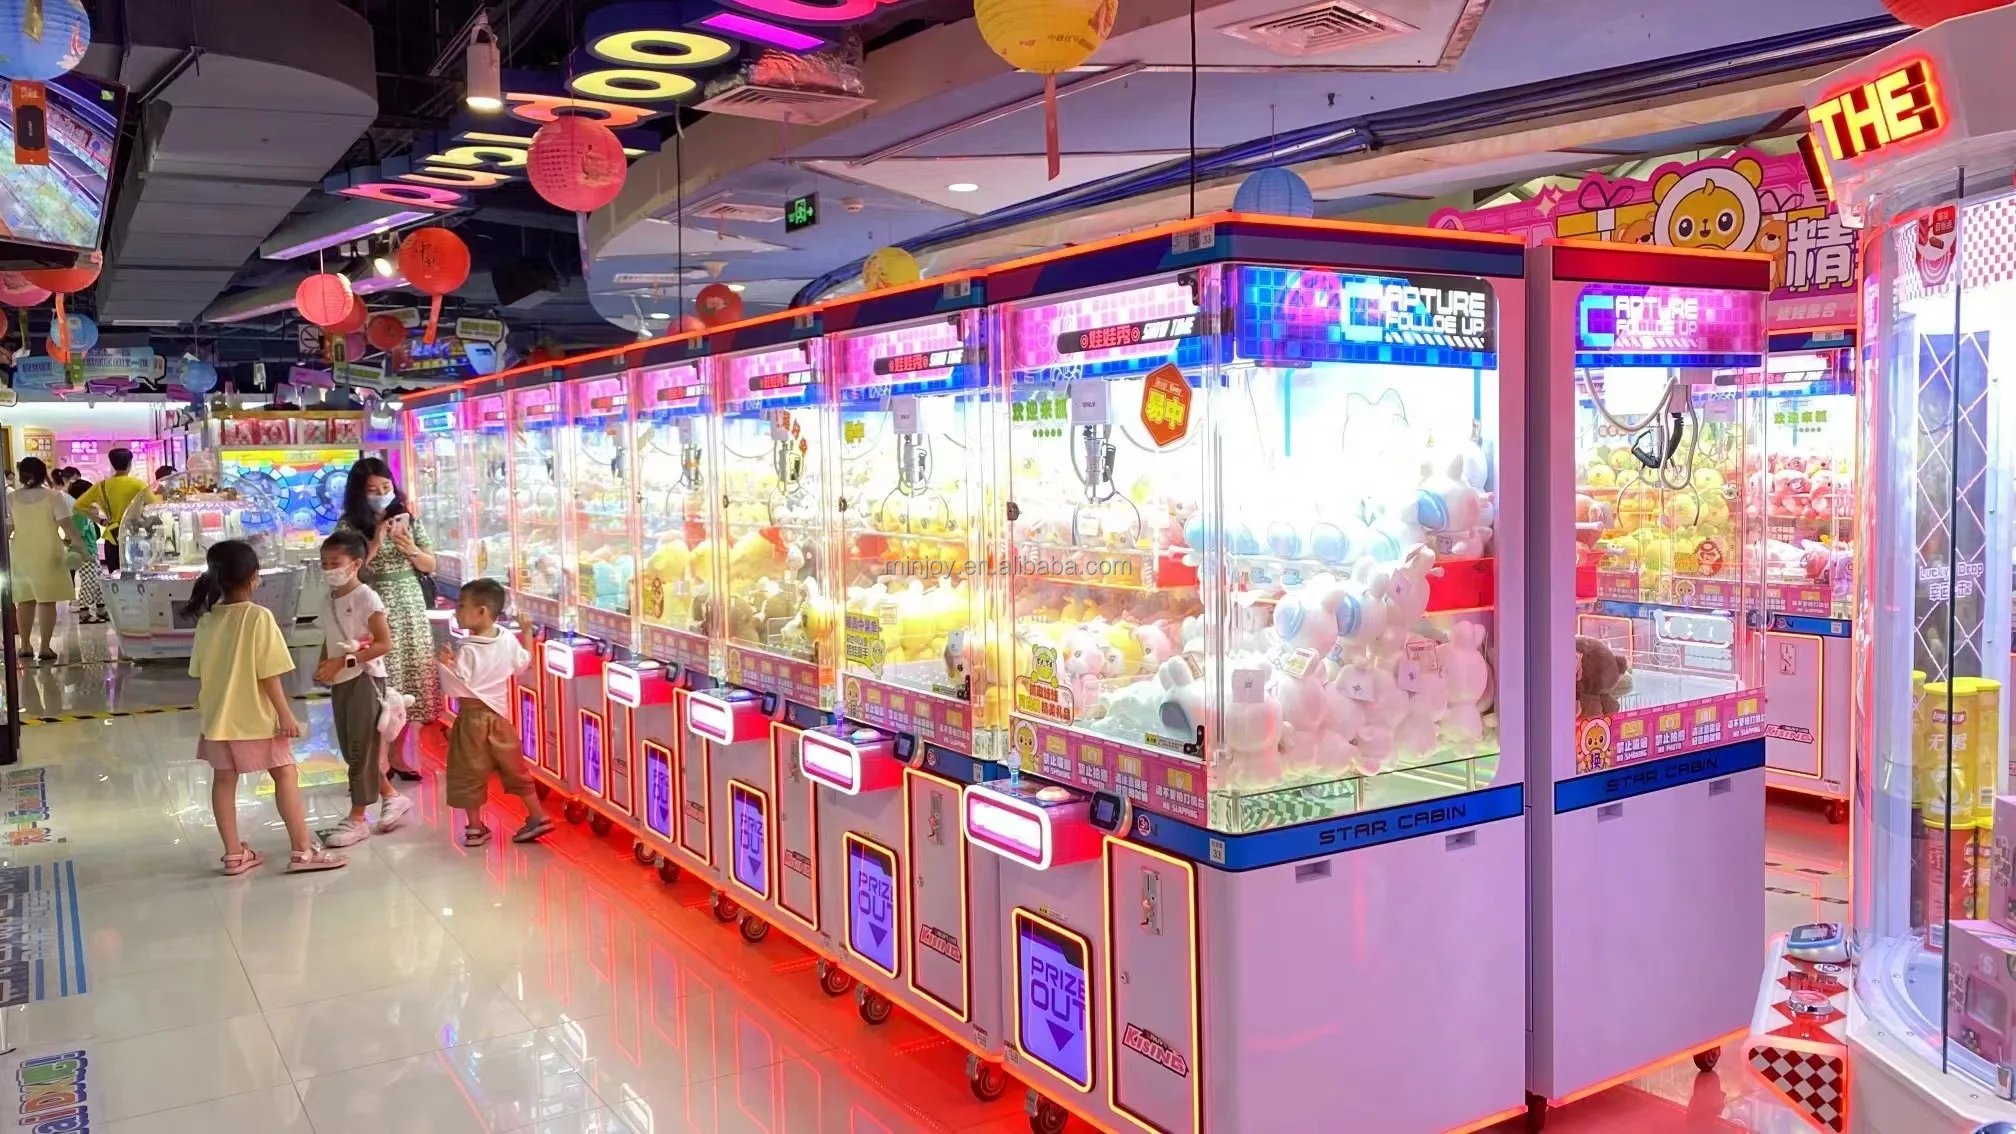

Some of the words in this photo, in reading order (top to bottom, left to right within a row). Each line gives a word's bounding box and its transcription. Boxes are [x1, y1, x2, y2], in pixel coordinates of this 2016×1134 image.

[1809, 62, 1940, 160] THE
[1462, 316, 1485, 336] UP
[1919, 563, 1950, 581] Lucky
[1957, 561, 1985, 578] Drop
[1606, 770, 1659, 793] STAR
[1666, 756, 1719, 780] CABIN
[1319, 818, 1388, 846] STAR
[1397, 804, 1466, 830] CABIN
